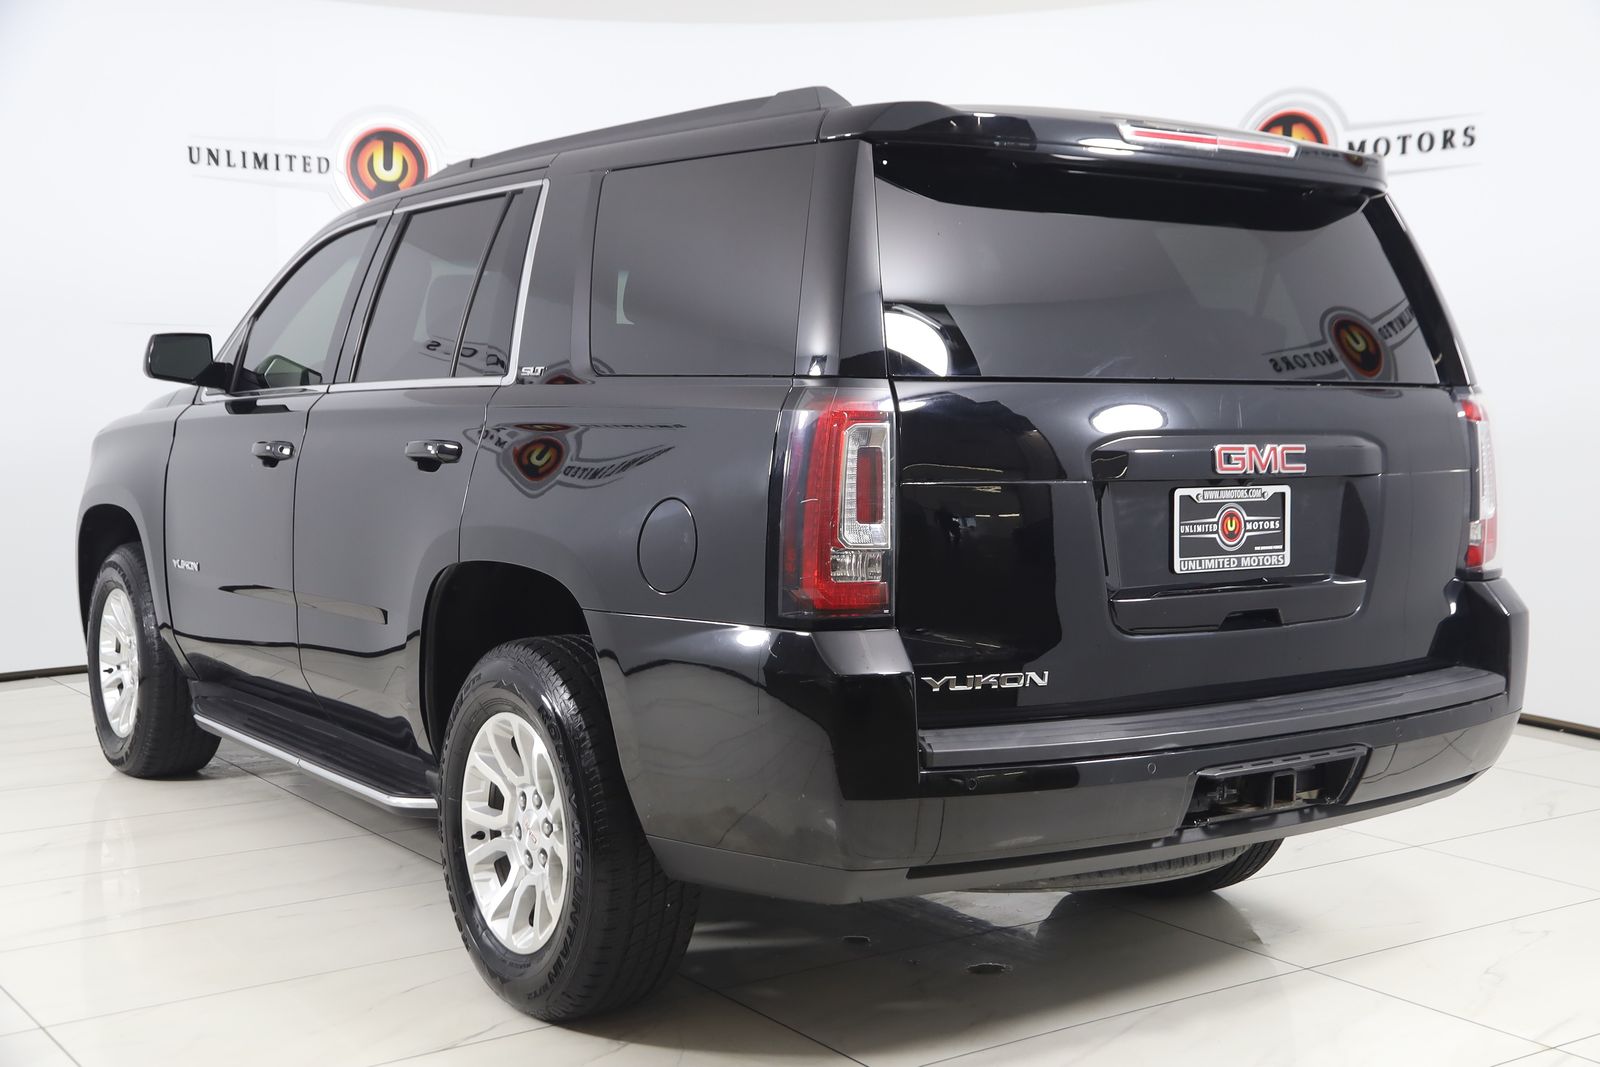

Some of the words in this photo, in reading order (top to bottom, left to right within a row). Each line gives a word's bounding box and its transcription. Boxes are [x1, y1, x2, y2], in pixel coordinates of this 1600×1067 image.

[187, 146, 330, 174] UNLIMITED
[520, 366, 545, 376] SLT
[1214, 444, 1307, 474] GMC
[1180, 523, 1218, 534] UNLIMITED
[1246, 520, 1280, 530] MOTORS
[1180, 557, 1238, 571] UNLIMITED
[1241, 555, 1284, 567] MOTORS
[920, 671, 1049, 692] YUKON
[548, 820, 584, 984] MOUNTAIN
